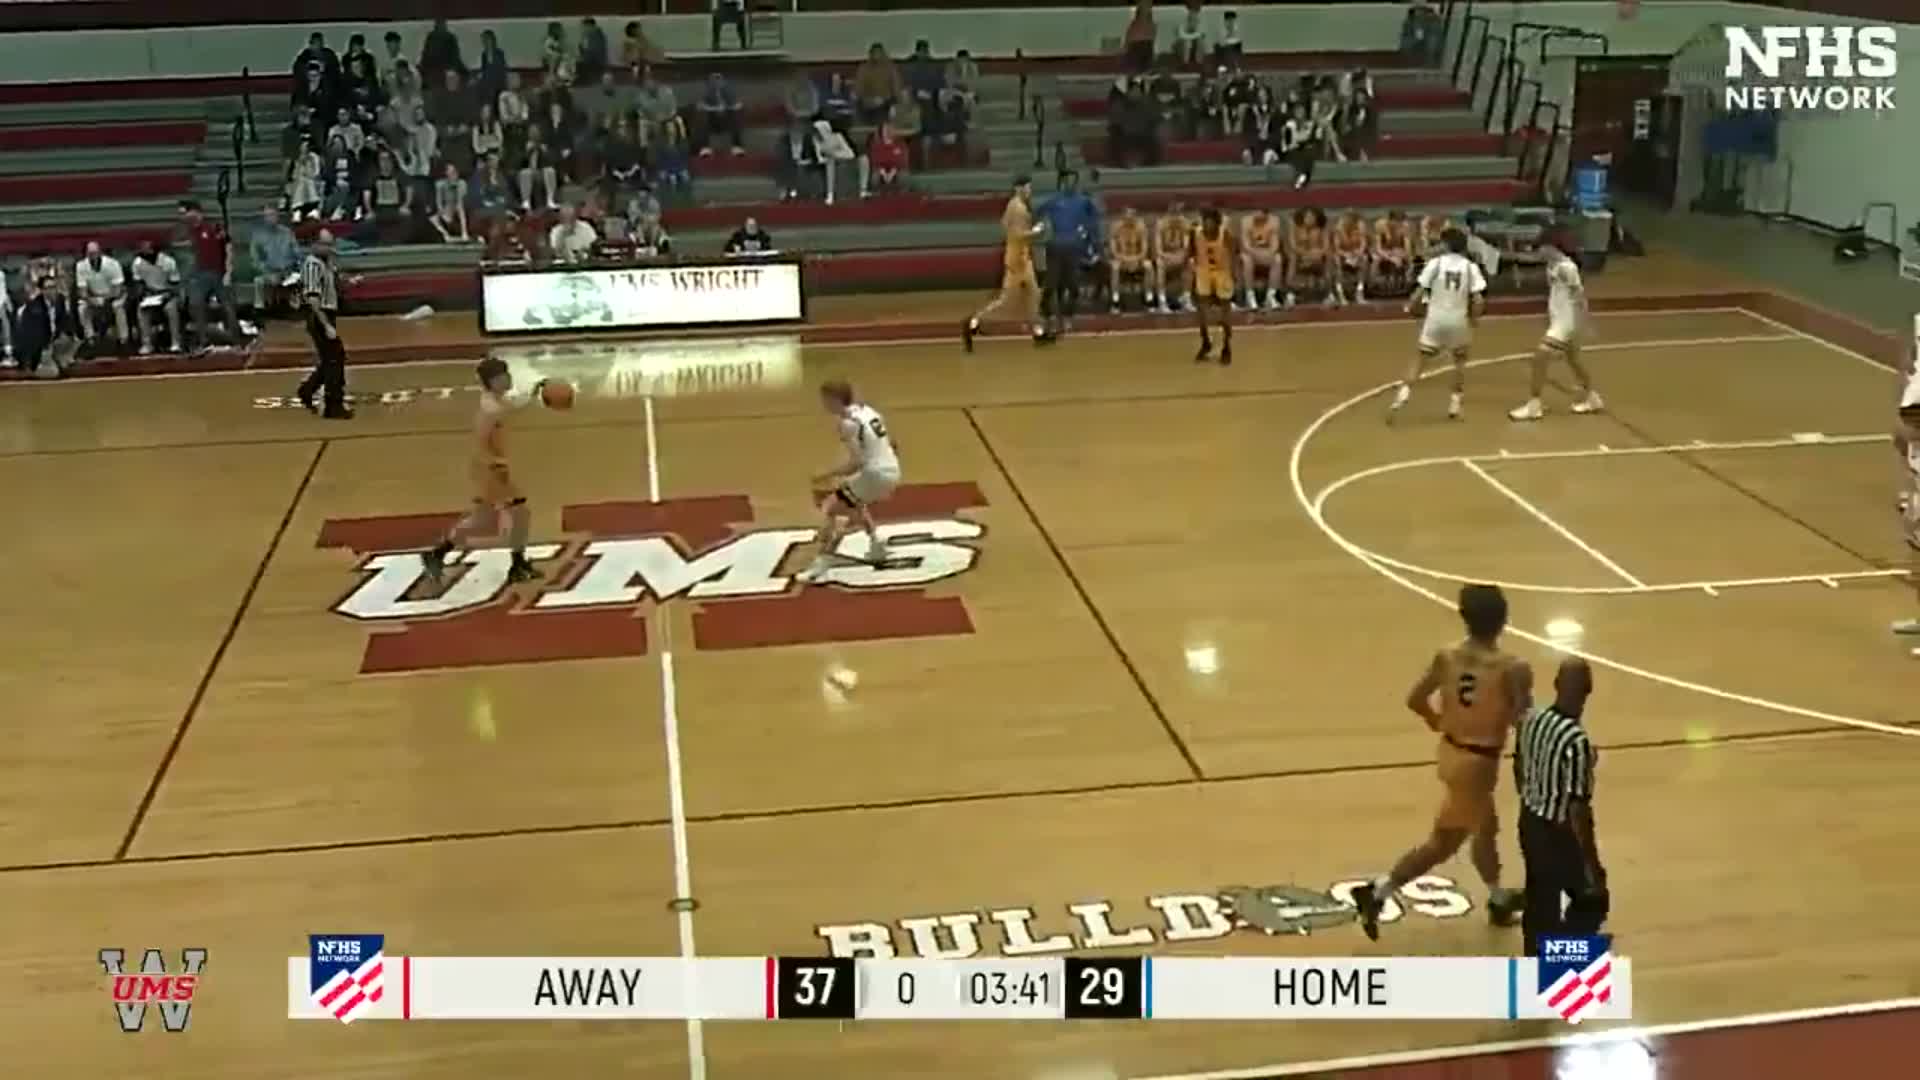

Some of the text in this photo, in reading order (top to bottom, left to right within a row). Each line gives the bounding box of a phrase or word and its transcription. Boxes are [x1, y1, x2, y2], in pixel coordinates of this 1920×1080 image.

[670, 268, 764, 292] WRIGHT
[335, 518, 985, 620] UMS
[1458, 673, 1476, 707] 2
[818, 874, 1472, 959] BULLDS
